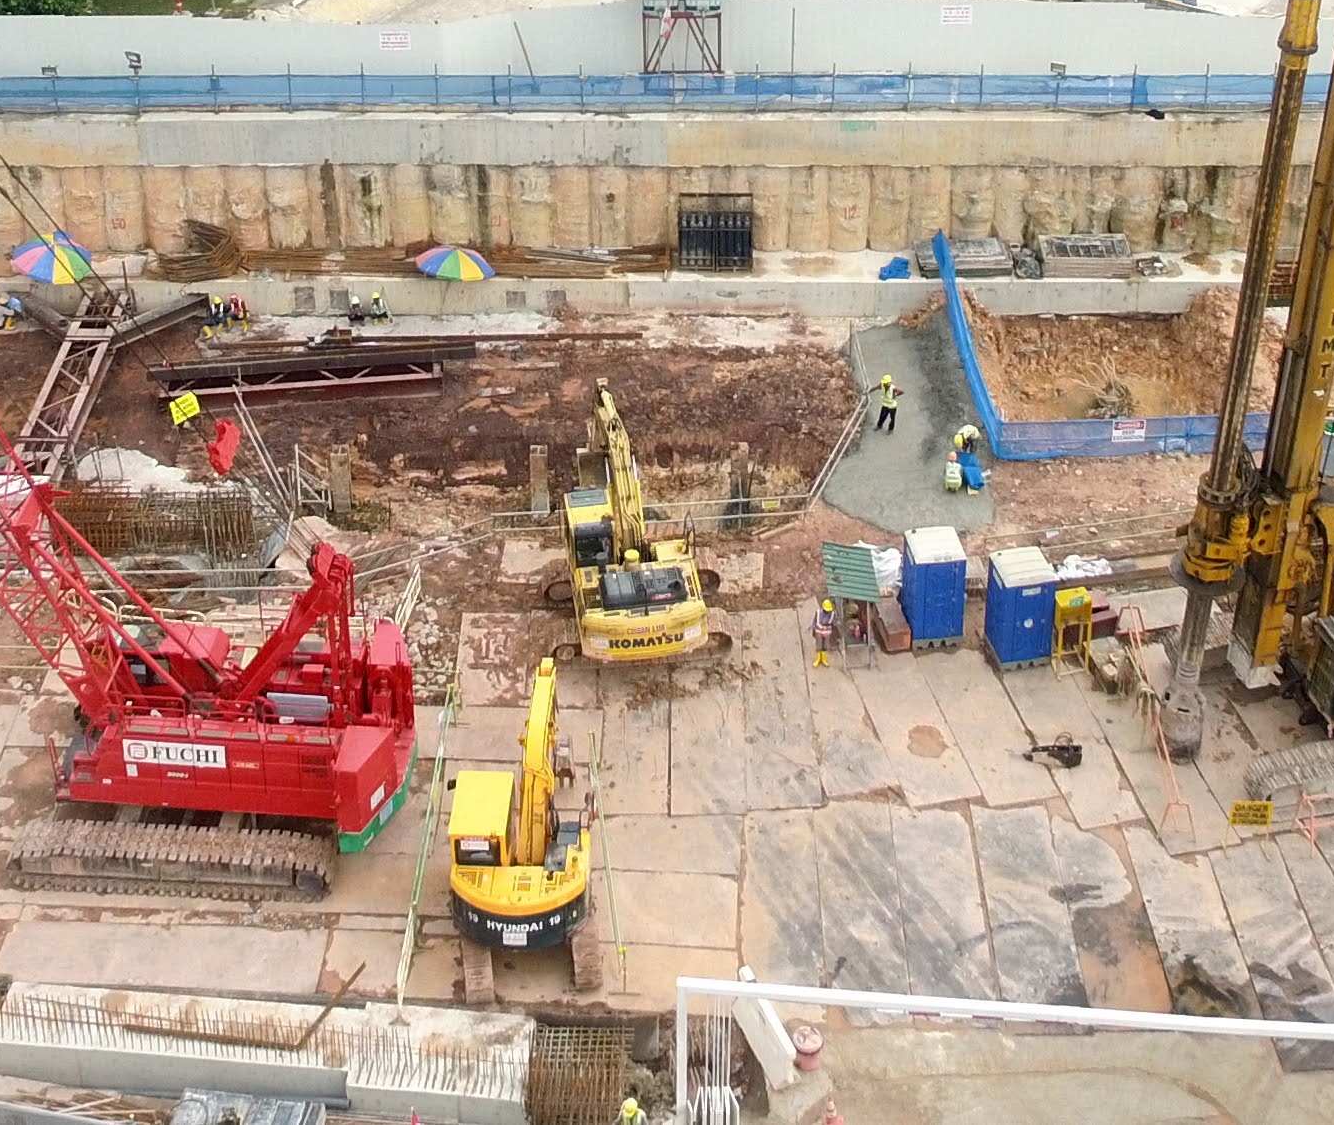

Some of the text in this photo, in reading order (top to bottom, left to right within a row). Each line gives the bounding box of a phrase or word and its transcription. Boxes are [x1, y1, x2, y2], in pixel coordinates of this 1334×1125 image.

[608, 632, 685, 649] KOMATSU
[153, 746, 220, 764] FUCHI
[486, 919, 544, 932] HYUNDAI
